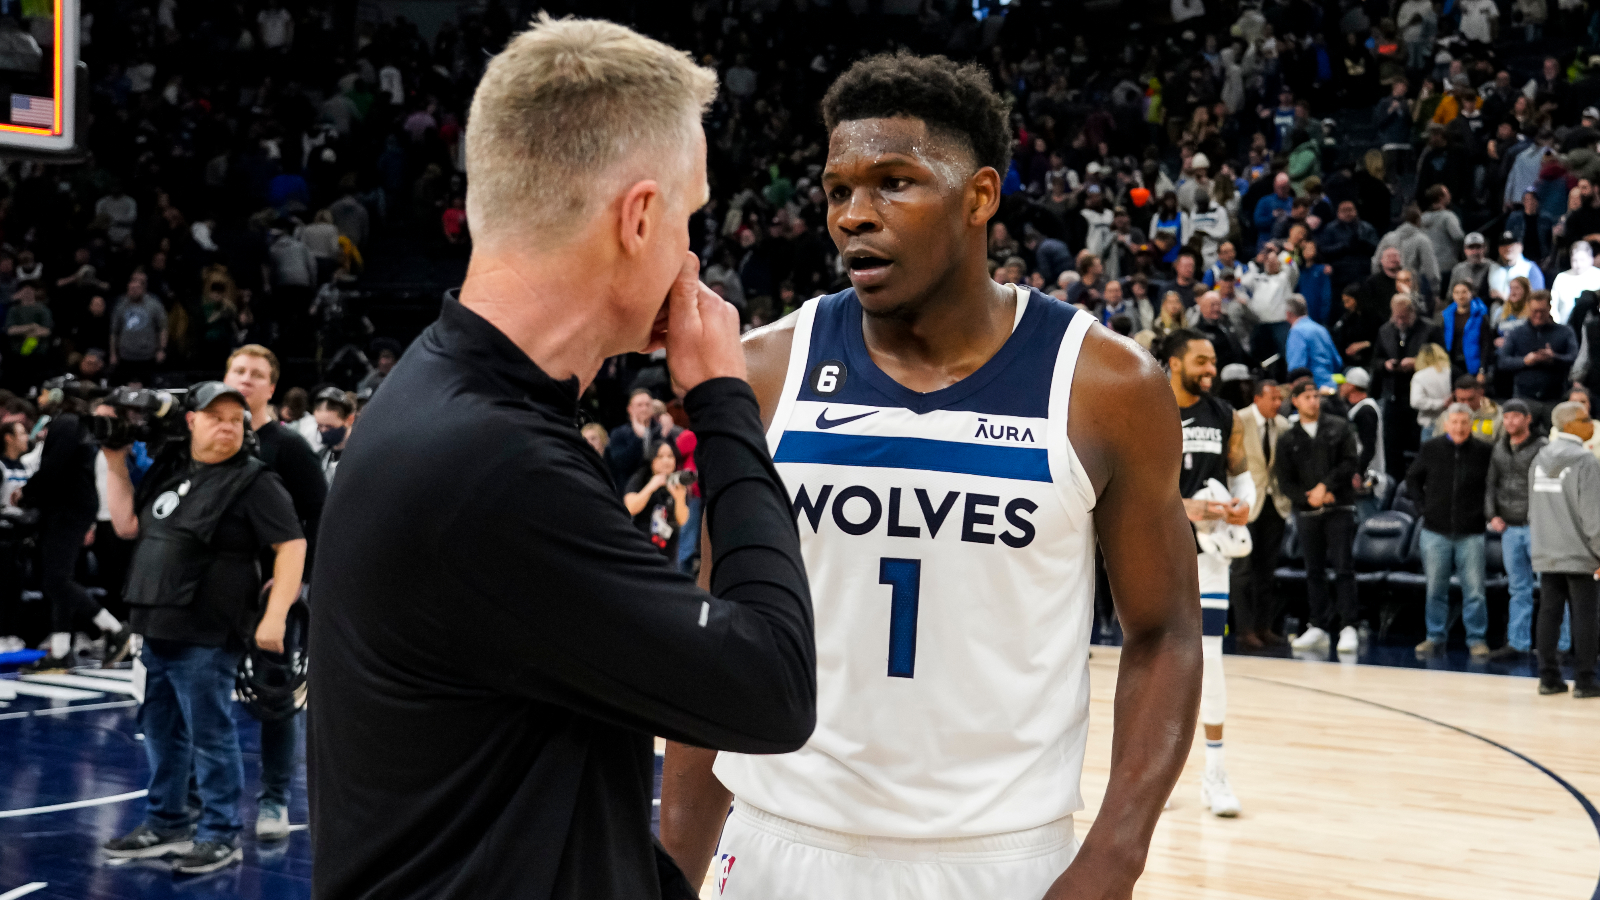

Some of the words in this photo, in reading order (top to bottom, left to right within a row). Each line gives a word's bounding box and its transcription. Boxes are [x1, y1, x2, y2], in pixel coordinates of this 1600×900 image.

[817, 365, 840, 393] 6
[792, 483, 1039, 549] WOLVES
[878, 556, 922, 679] 1
